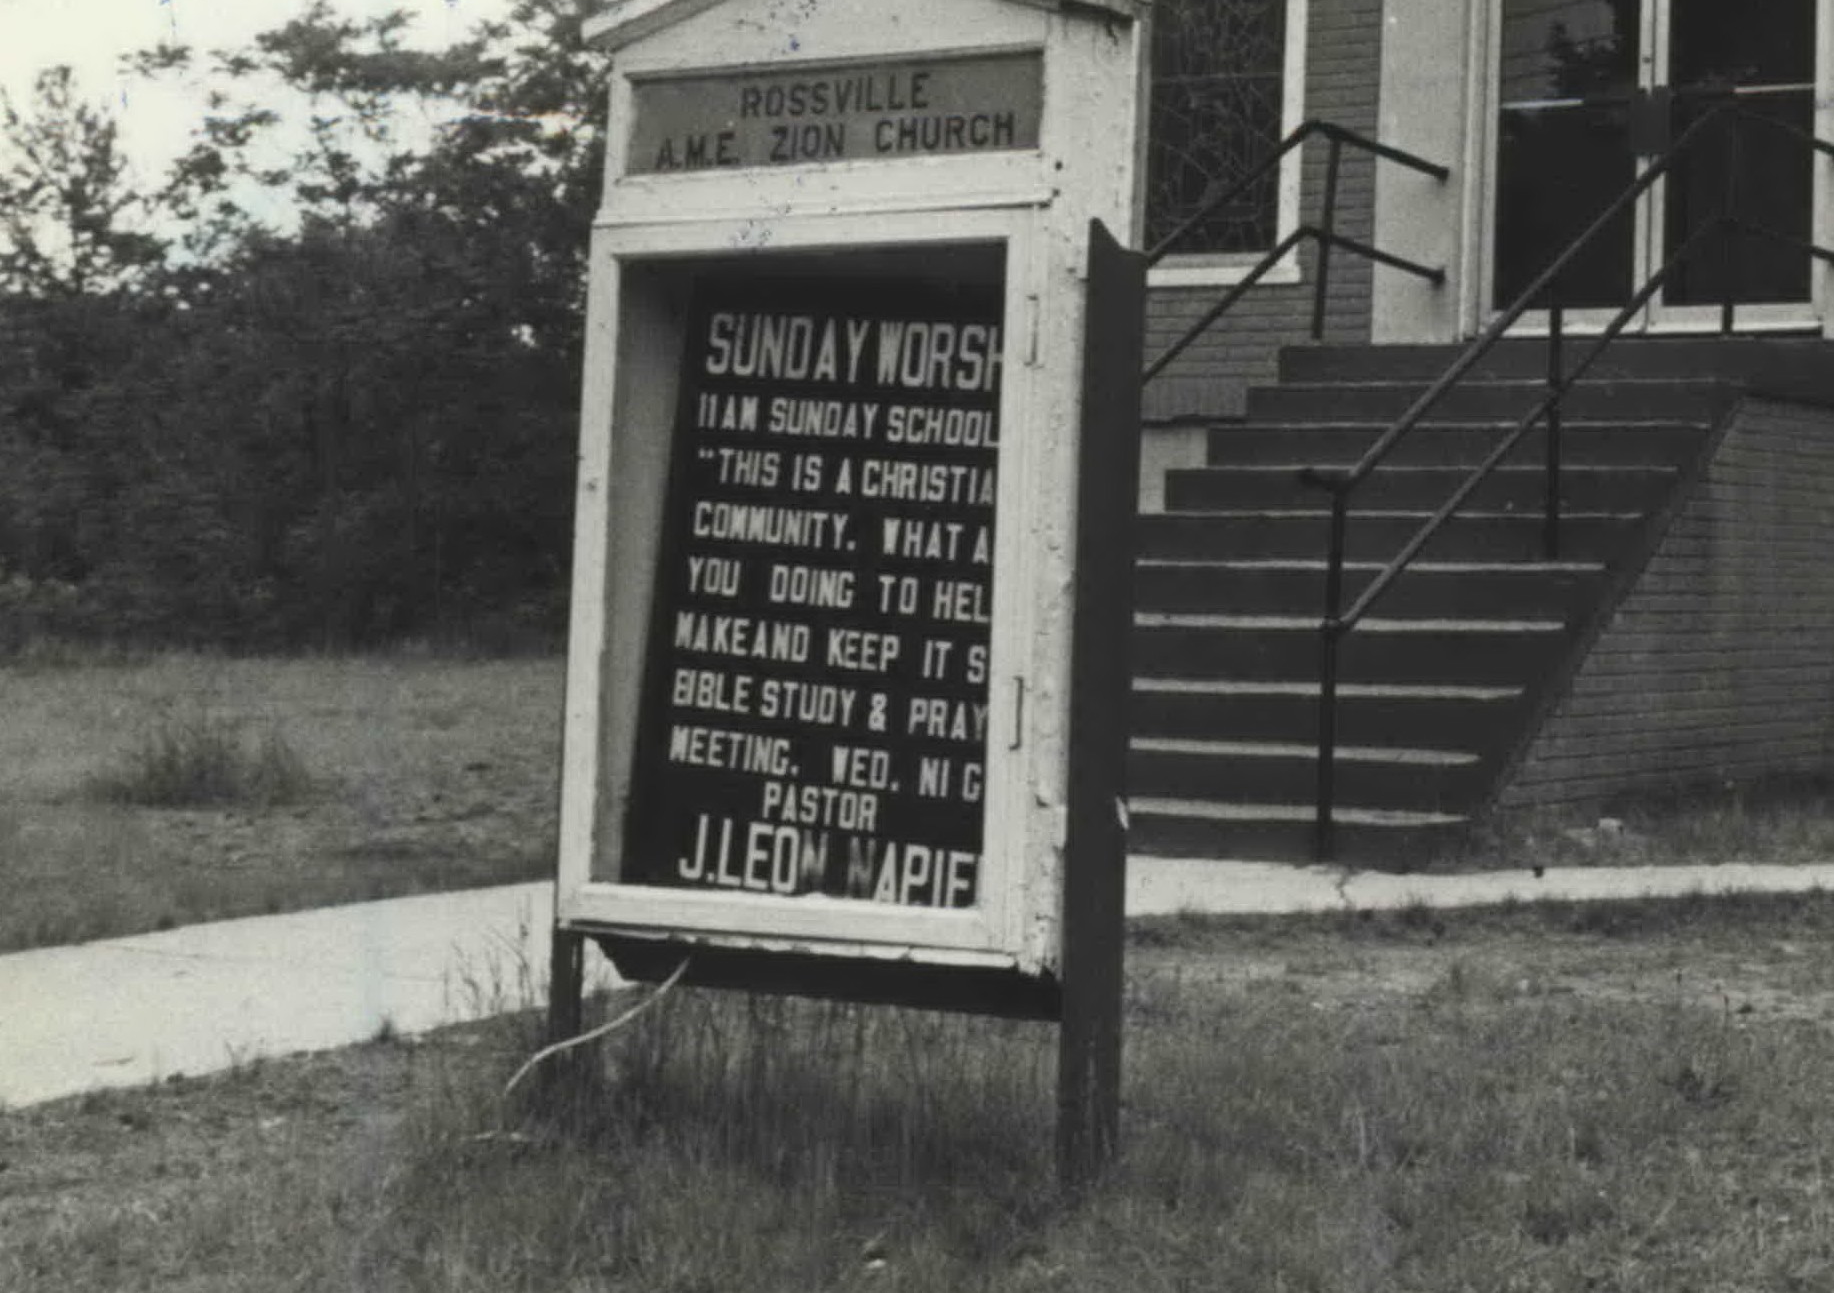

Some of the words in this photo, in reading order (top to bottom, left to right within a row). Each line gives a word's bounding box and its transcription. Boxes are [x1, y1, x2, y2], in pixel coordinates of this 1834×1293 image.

[739, 72, 931, 120] ROSSVILLE
[655, 131, 740, 170] A.M.E.
[769, 123, 845, 163] ZION
[873, 110, 1015, 154] CHURCH
[705, 313, 870, 384] SUNDAY
[768, 397, 879, 440] SUNDAY
[887, 405, 1000, 448] SCHOOL
[791, 454, 823, 492] IS
[835, 456, 851, 496] A
[861, 459, 994, 506] CHRISTIA
[694, 501, 857, 551] COMMUNITY.
[882, 516, 964, 562] WHAT
[972, 525, 990, 565] A
[689, 556, 741, 597] YOU
[770, 564, 856, 609] DOING
[878, 574, 919, 615] TO
[933, 580, 992, 624] HEL
[827, 627, 900, 674] KEEP
[922, 640, 952, 680] IT
[966, 645, 986, 684] S
[672, 668, 754, 715] BIBLE
[759, 679, 857, 728] STUDY
[867, 692, 888, 733] &
[907, 697, 988, 742] PRAY
[669, 724, 800, 777] MEETING.
[832, 745, 900, 793] WED.
[762, 781, 879, 832] PASTOR
